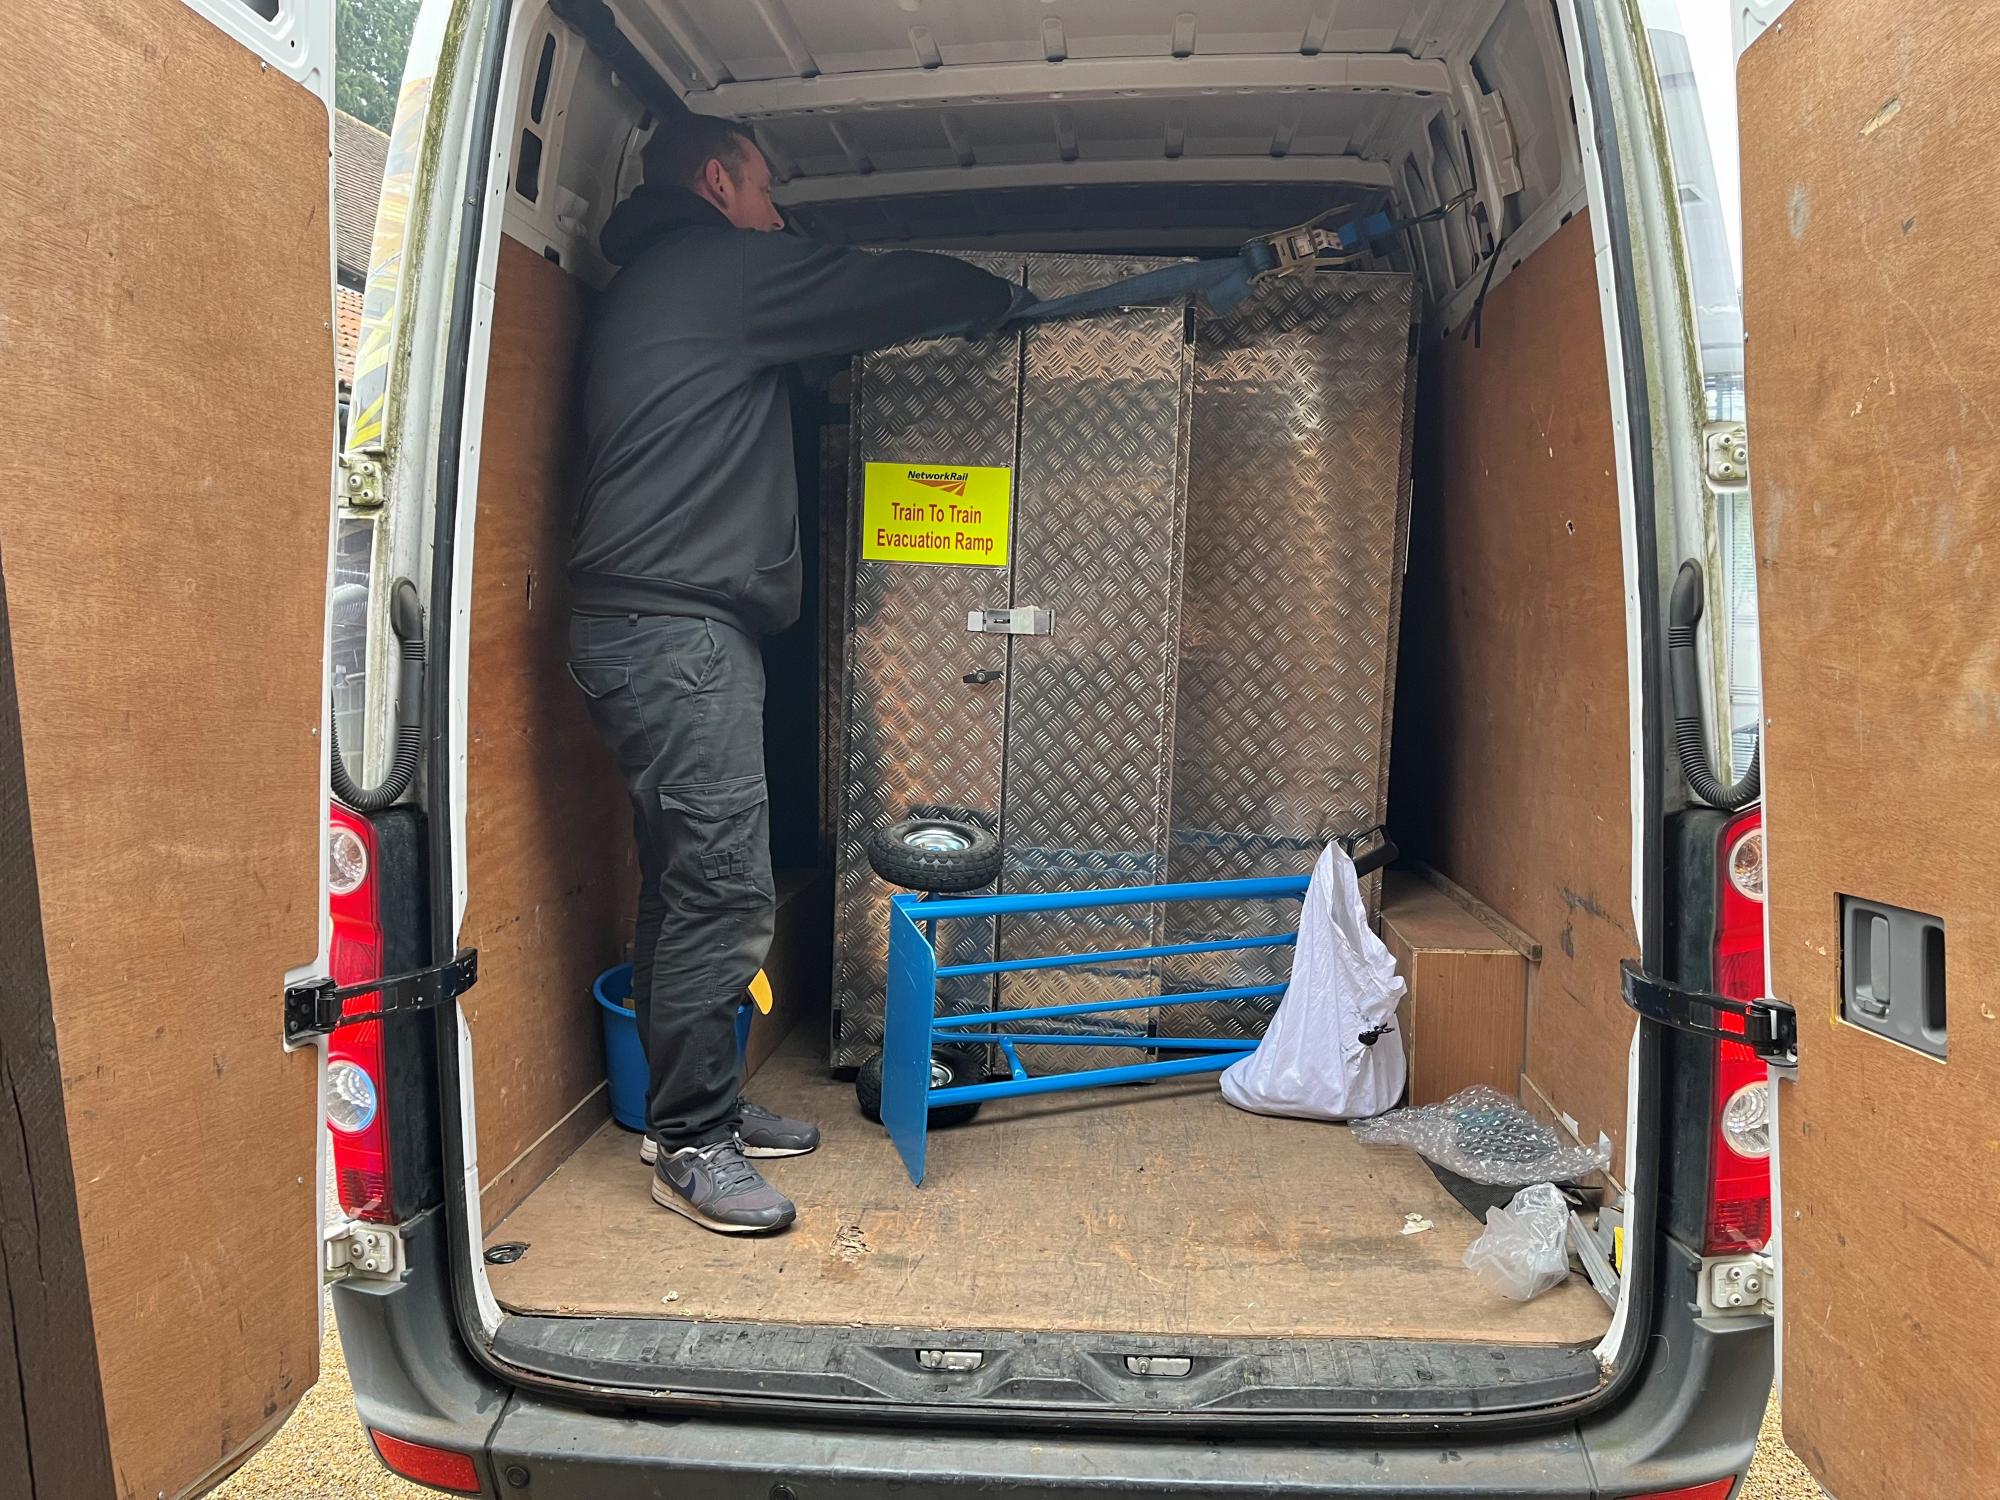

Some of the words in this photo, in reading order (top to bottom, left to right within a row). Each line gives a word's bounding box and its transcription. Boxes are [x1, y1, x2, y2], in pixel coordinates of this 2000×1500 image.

[891, 502, 924, 521] Train
[929, 504, 945, 522] To
[949, 505, 982, 524] Train
[877, 528, 950, 549] Evacuation
[955, 532, 993, 555] Ramp
